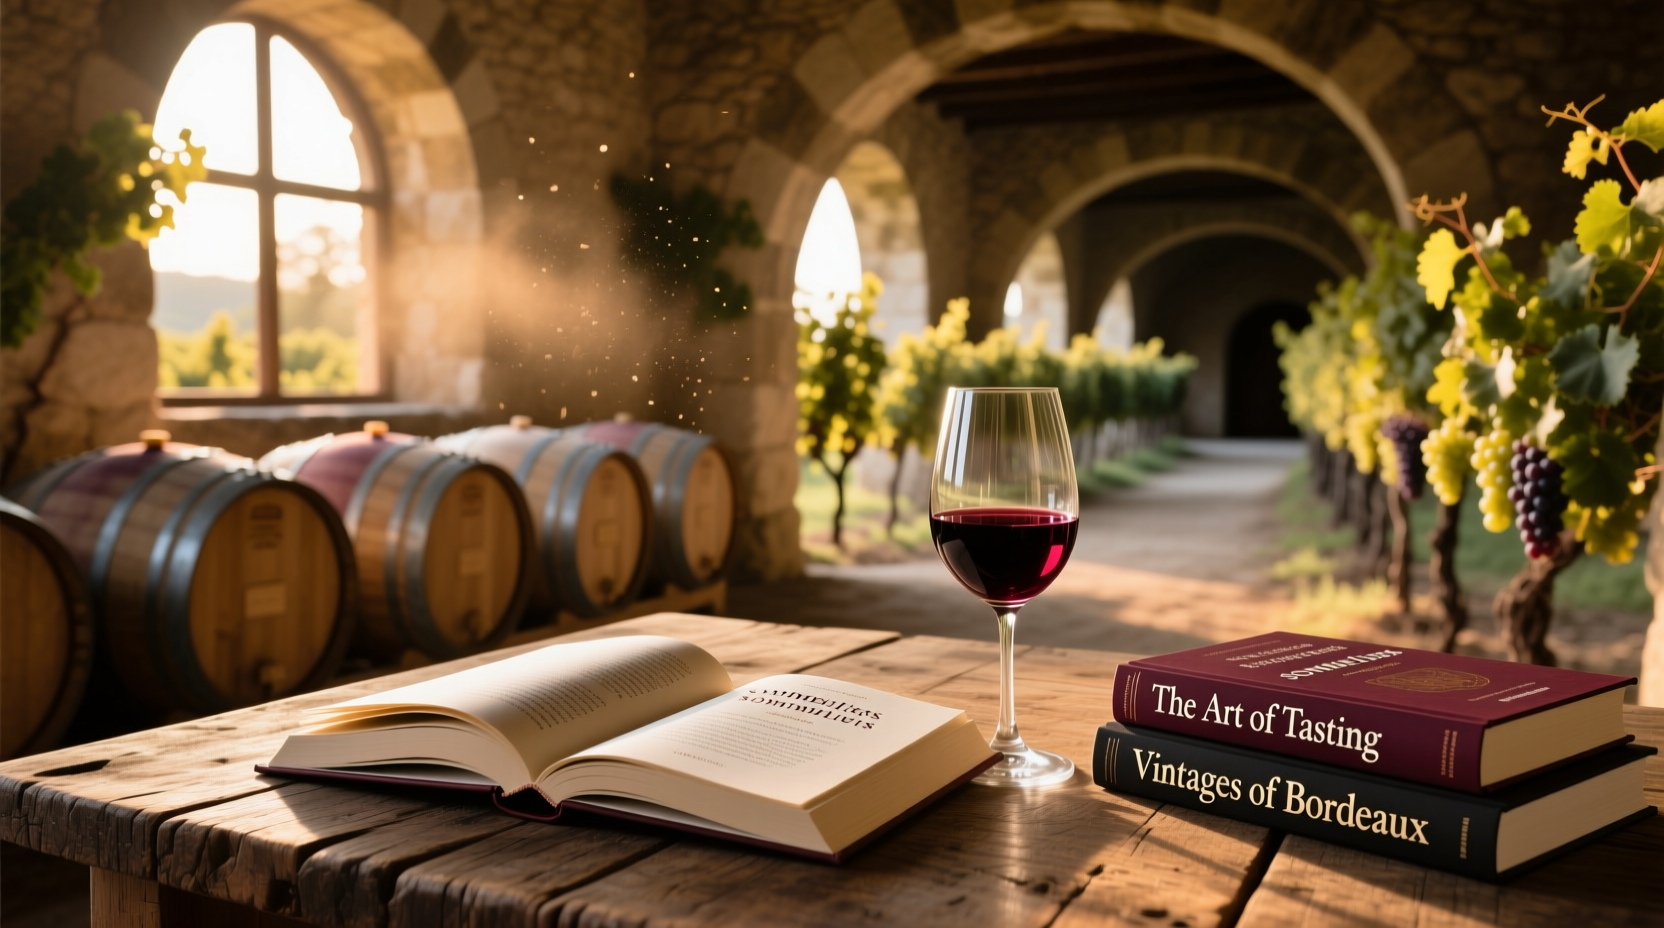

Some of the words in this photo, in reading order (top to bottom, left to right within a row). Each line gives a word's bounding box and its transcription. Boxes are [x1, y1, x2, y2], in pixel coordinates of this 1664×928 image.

[1151, 683, 1197, 721] The
[1200, 692, 1245, 728] Art
[1249, 702, 1281, 735] of
[1282, 705, 1383, 764] Tasting
[1132, 747, 1242, 804] Vintages
[1248, 776, 1281, 809] of
[1282, 780, 1429, 845] Bordeaux
